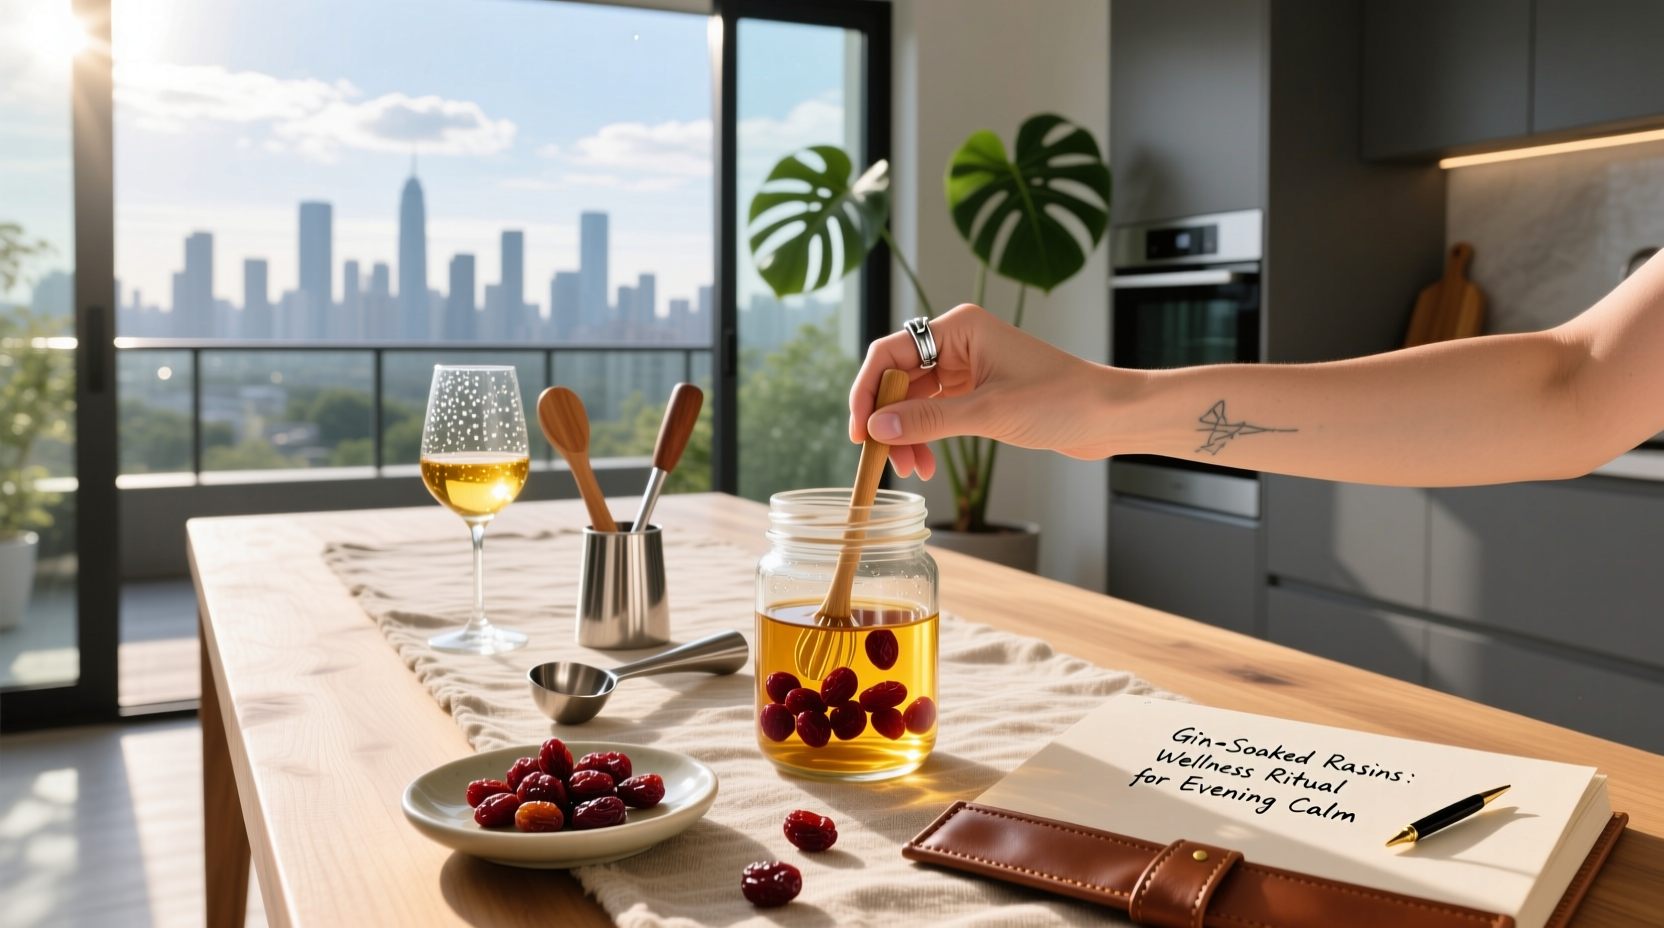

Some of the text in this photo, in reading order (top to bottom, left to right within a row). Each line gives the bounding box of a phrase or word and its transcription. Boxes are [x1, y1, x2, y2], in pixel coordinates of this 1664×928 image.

[1156, 748, 1348, 794] Wellness Ritual
[1172, 727, 1415, 784] Gin-Soaked Rasins:
[1128, 767, 1356, 823] for Evening Calm
